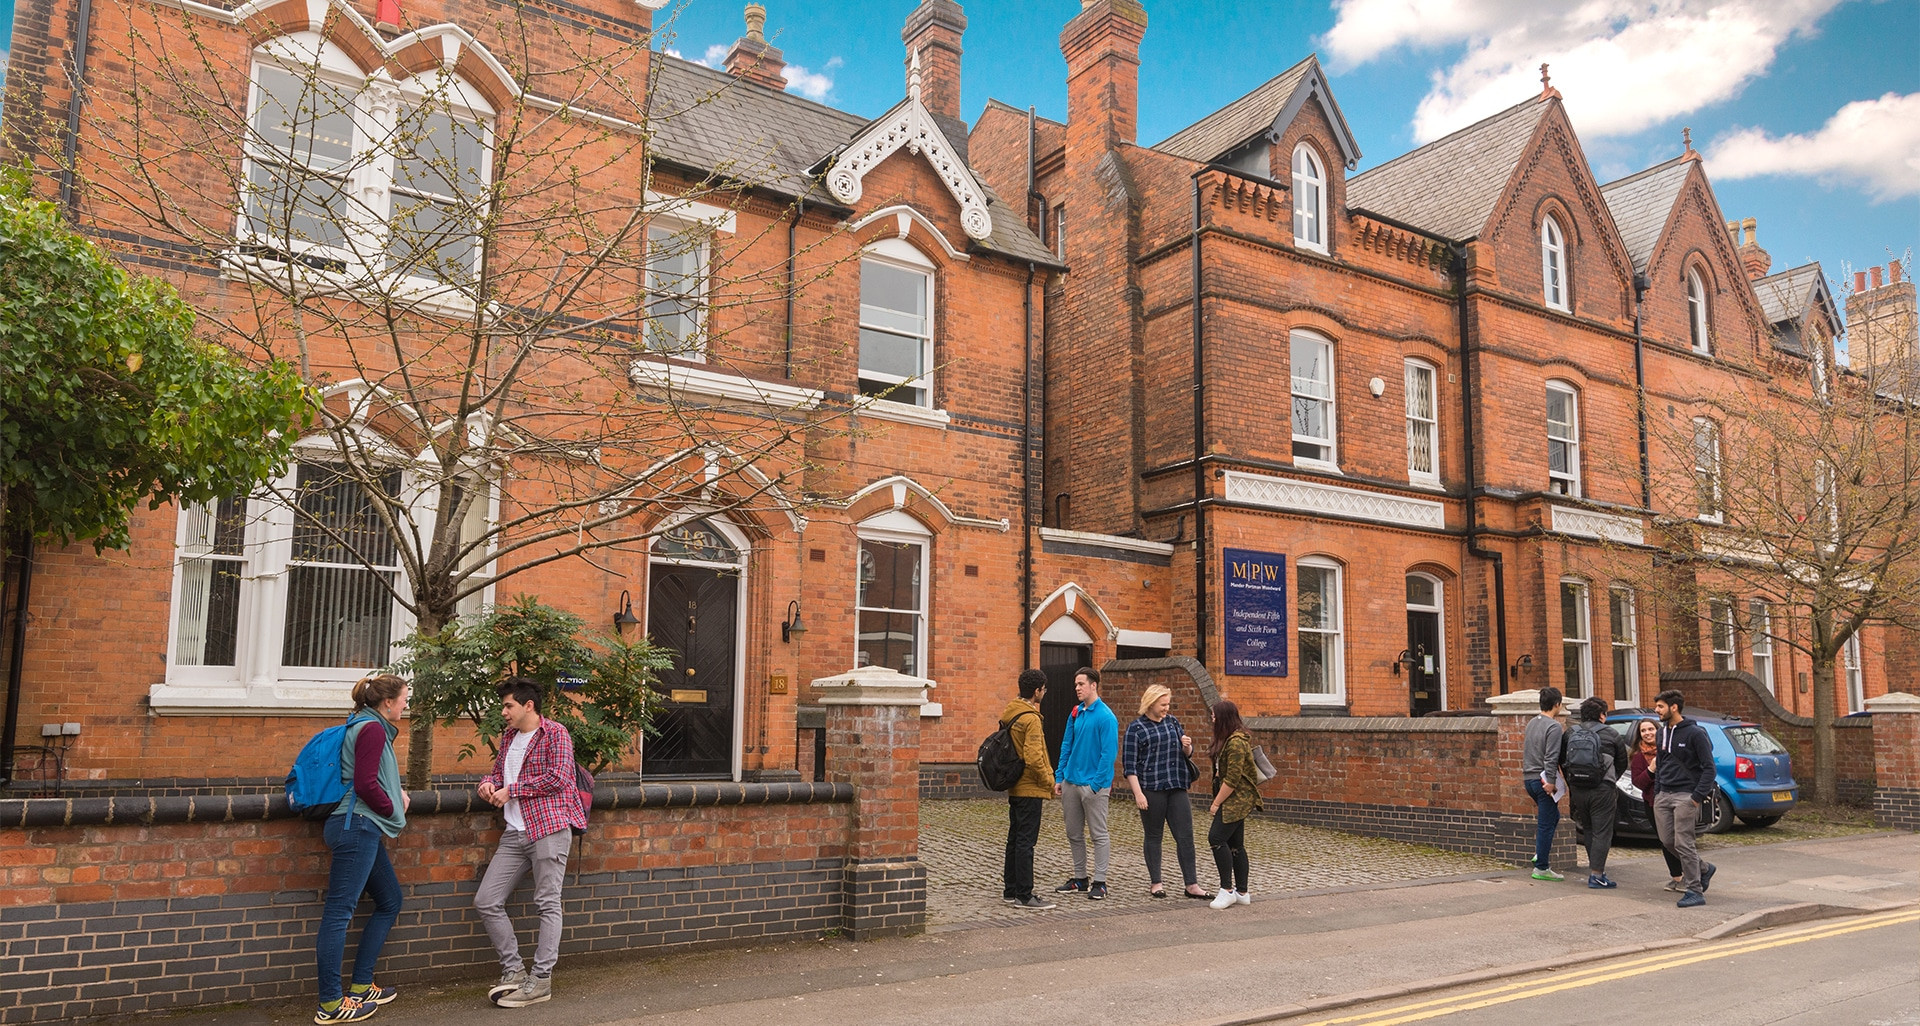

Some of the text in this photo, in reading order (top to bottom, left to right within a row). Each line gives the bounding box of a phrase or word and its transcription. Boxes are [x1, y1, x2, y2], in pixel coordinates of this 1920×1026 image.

[684, 530, 704, 550] 18
[1411, 583, 1421, 597] 17
[688, 600, 697, 610] 18
[1233, 609, 1266, 620] Independent
[1235, 624, 1277, 634] and Sixth Form
[1246, 638, 1267, 649] College
[774, 678, 785, 690] 18
